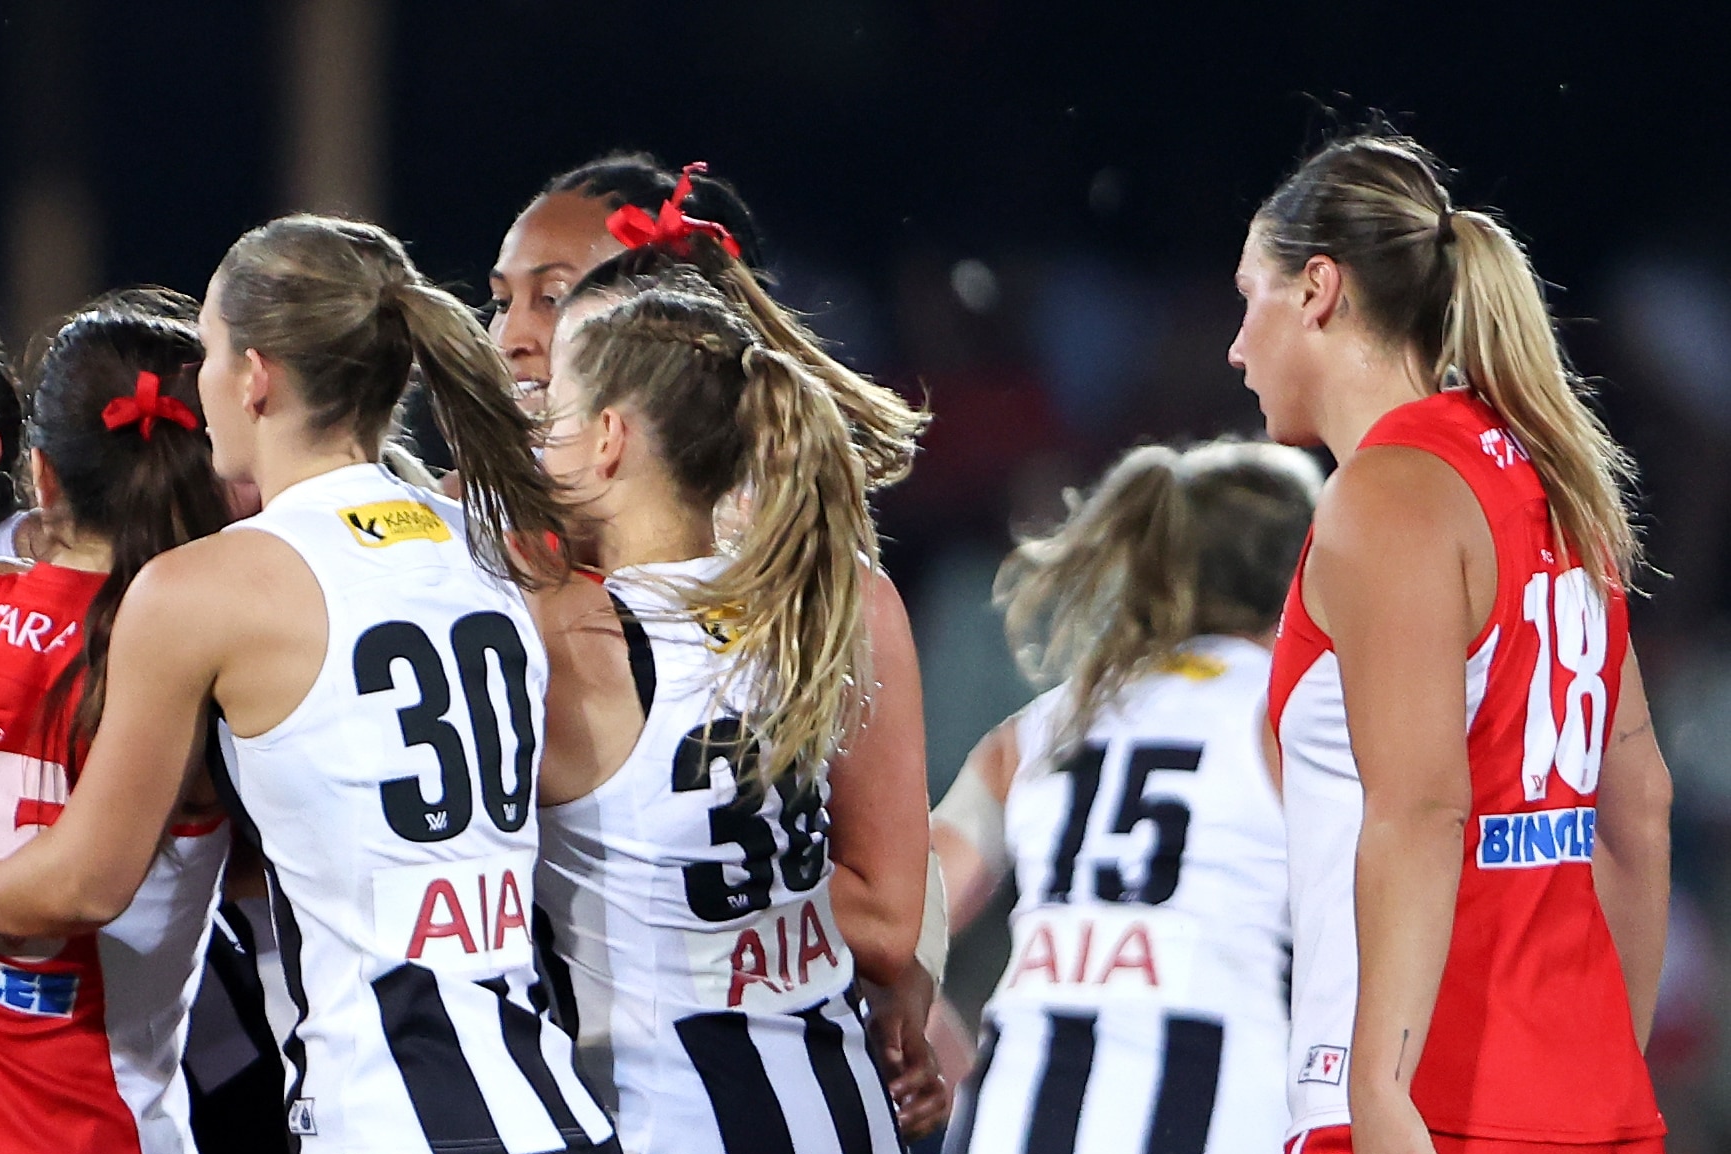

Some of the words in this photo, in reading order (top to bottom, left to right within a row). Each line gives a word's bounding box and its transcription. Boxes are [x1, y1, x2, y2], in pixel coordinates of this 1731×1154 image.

[352, 611, 536, 842] 30
[1522, 567, 1609, 801] 18
[1041, 737, 1205, 905] 15
[405, 869, 533, 959] AIA
[728, 900, 839, 1008] AIA
[1007, 919, 1160, 987] AIA
